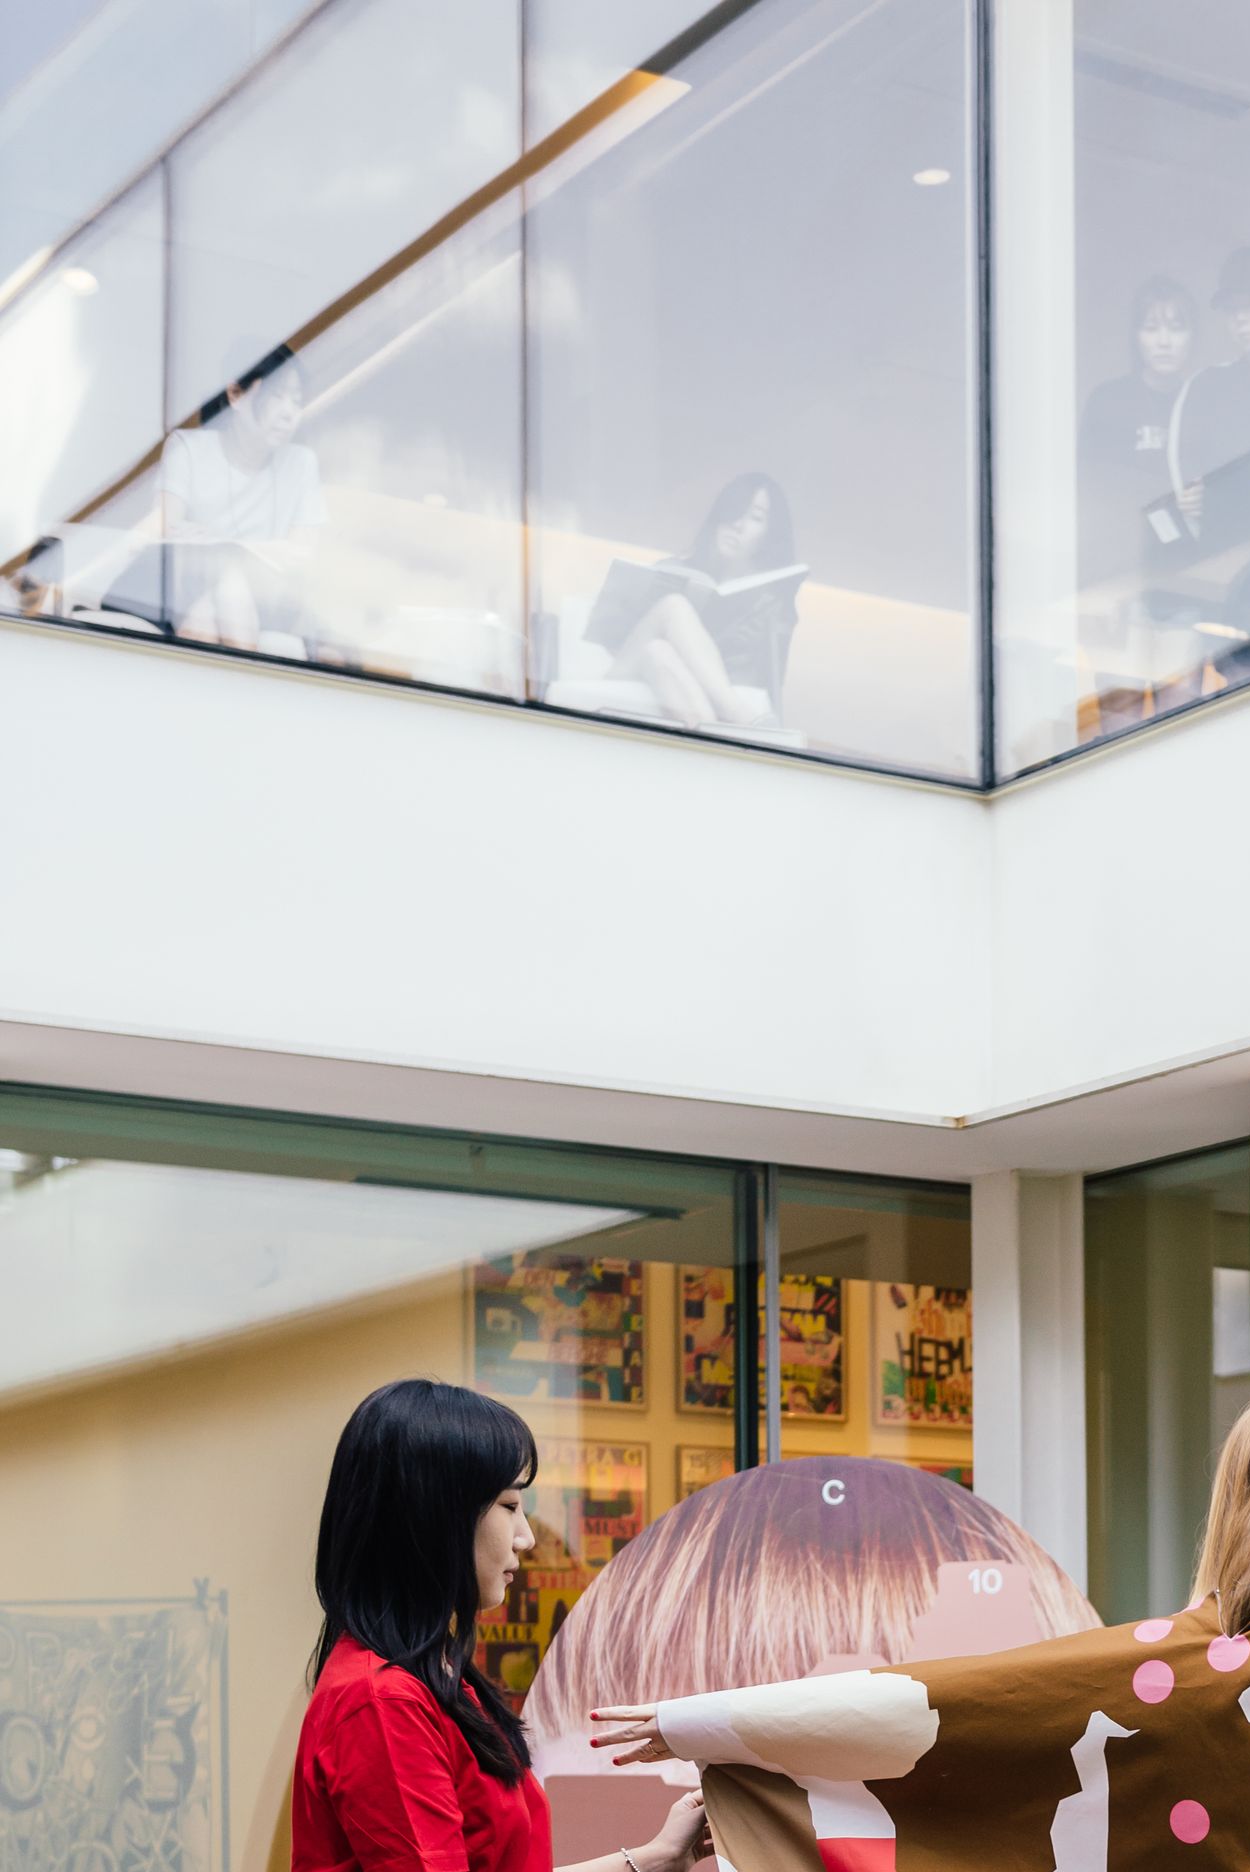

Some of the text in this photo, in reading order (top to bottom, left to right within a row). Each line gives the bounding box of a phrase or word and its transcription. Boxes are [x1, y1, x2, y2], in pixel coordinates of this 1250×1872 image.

[822, 1479, 846, 1506] C
[584, 1519, 640, 1536] MUST
[968, 1568, 1003, 1595] 10
[478, 1624, 535, 1640] VALUE
